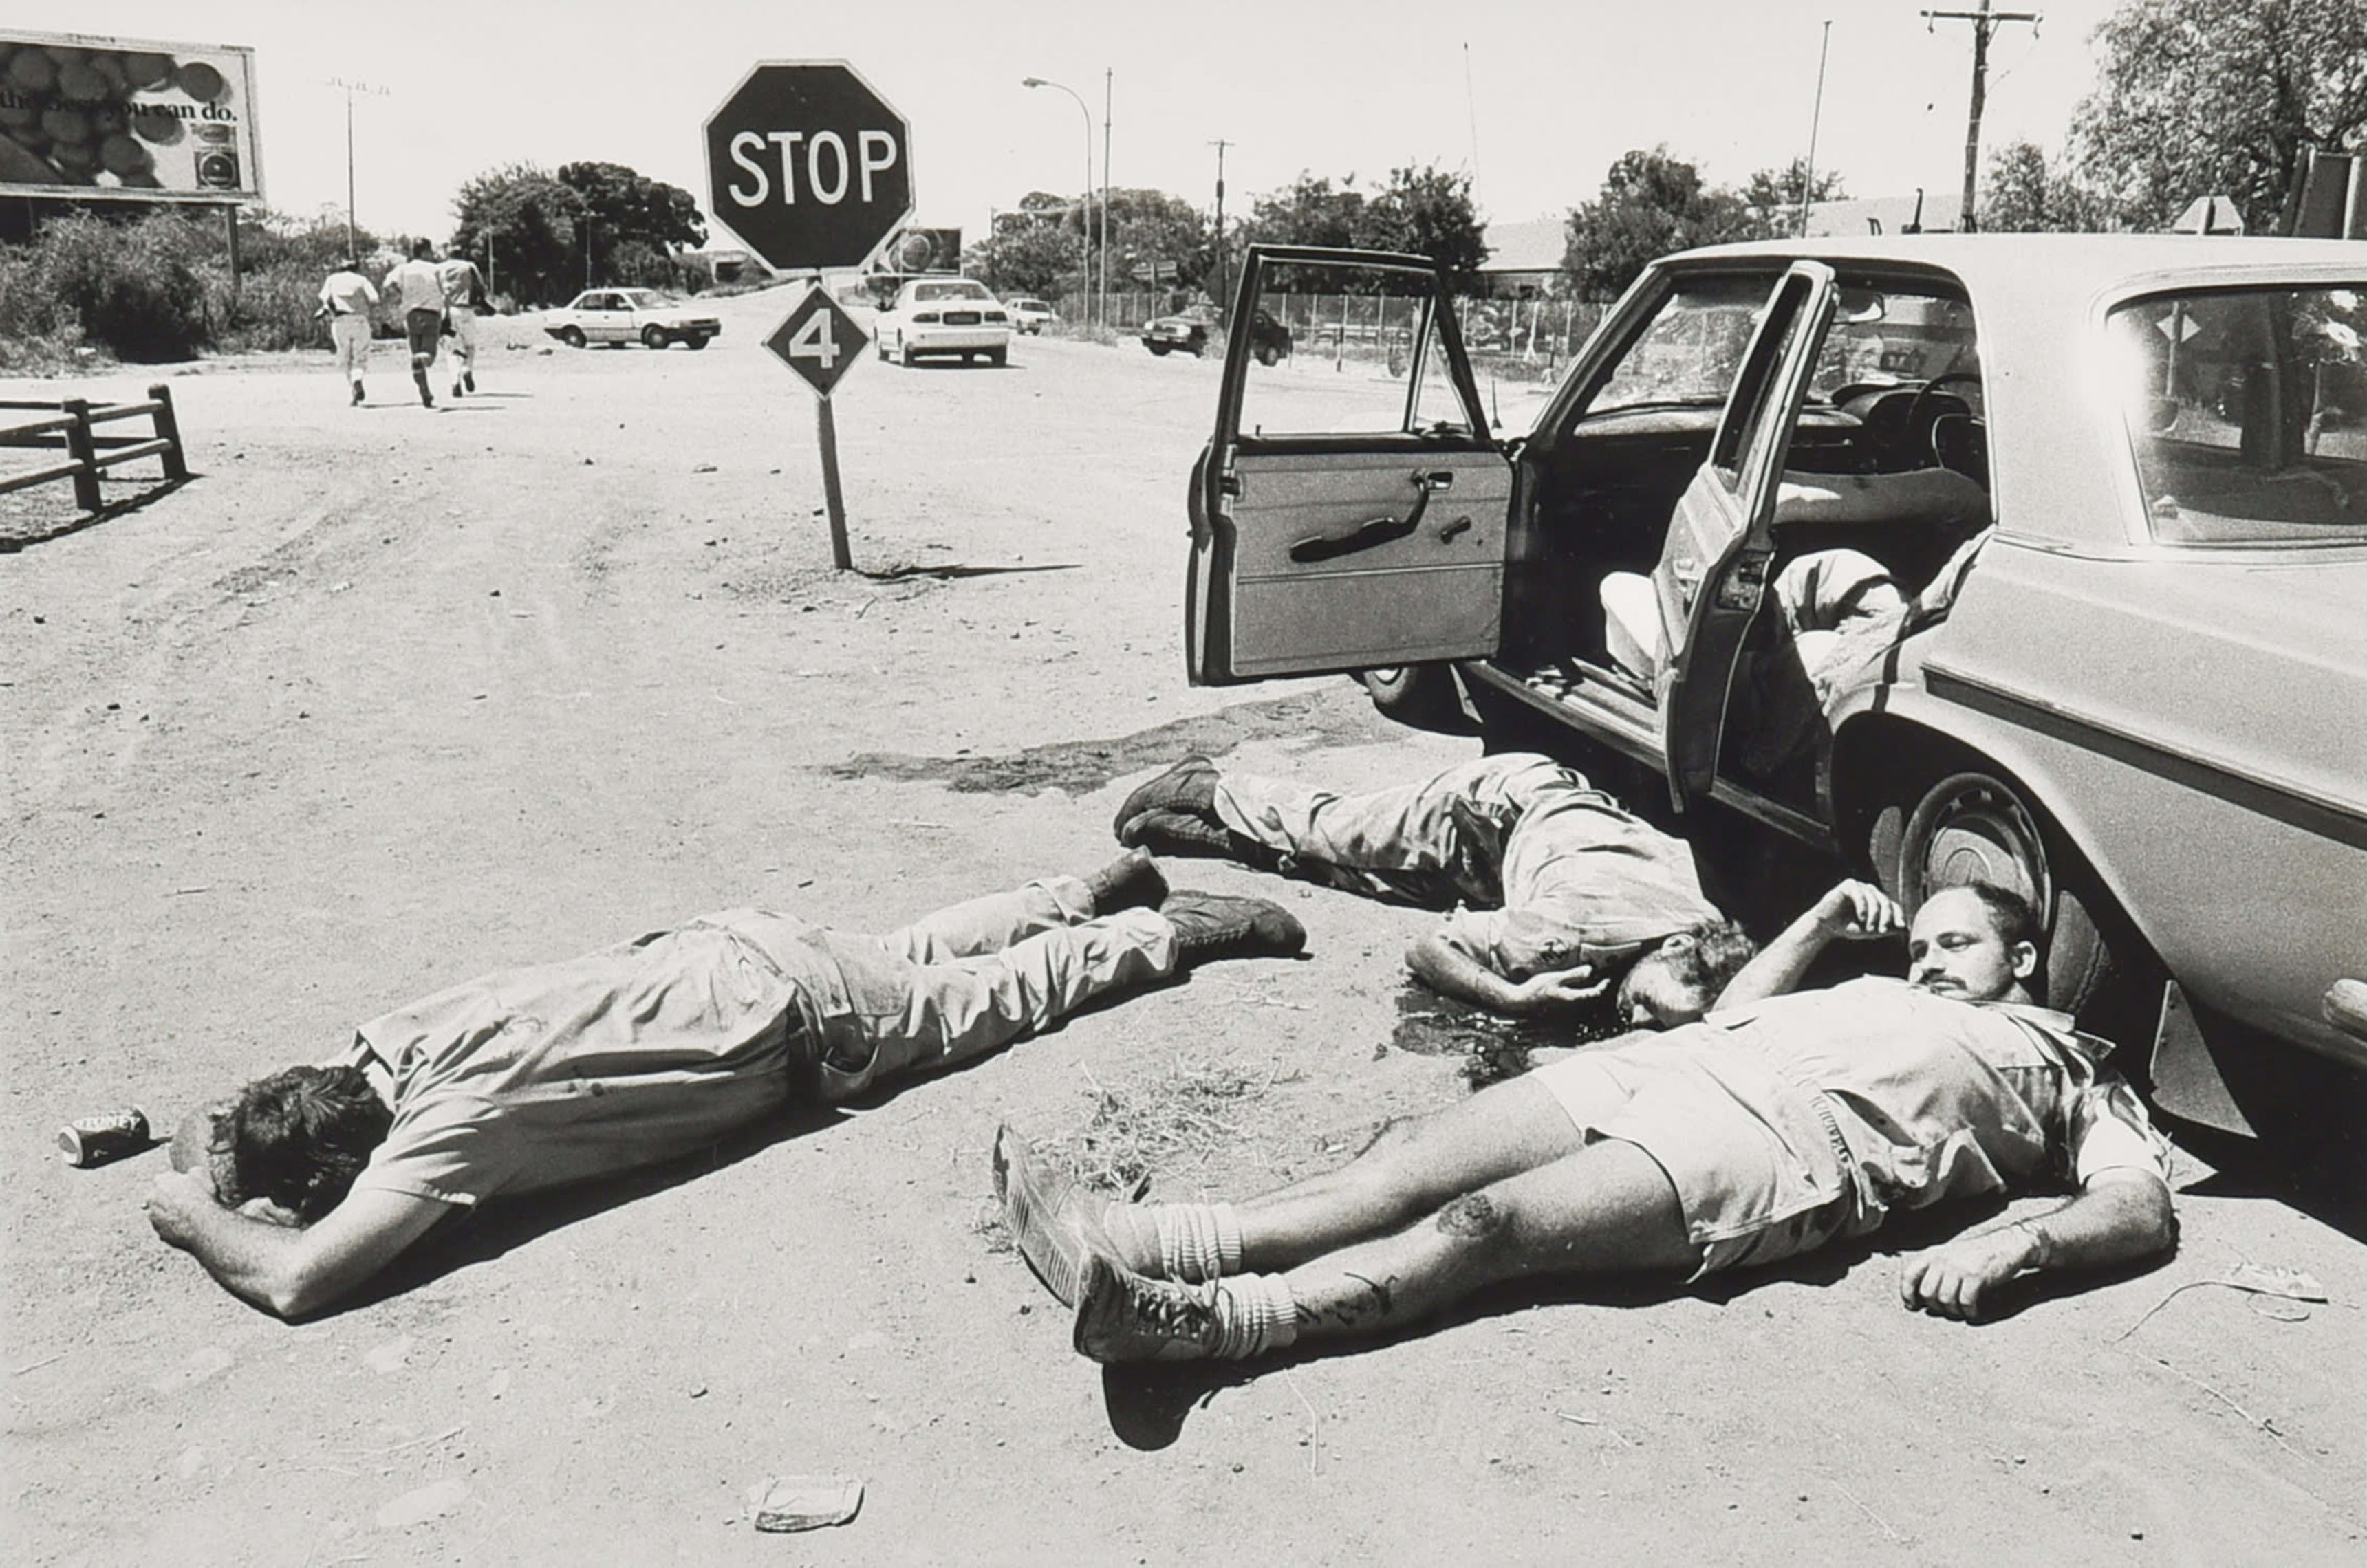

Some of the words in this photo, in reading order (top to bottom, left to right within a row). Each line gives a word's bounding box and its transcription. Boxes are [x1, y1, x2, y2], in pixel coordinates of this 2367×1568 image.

[153, 104, 196, 119] can
[201, 100, 237, 122] do.
[729, 131, 897, 208] STOP
[789, 308, 841, 369] 4
